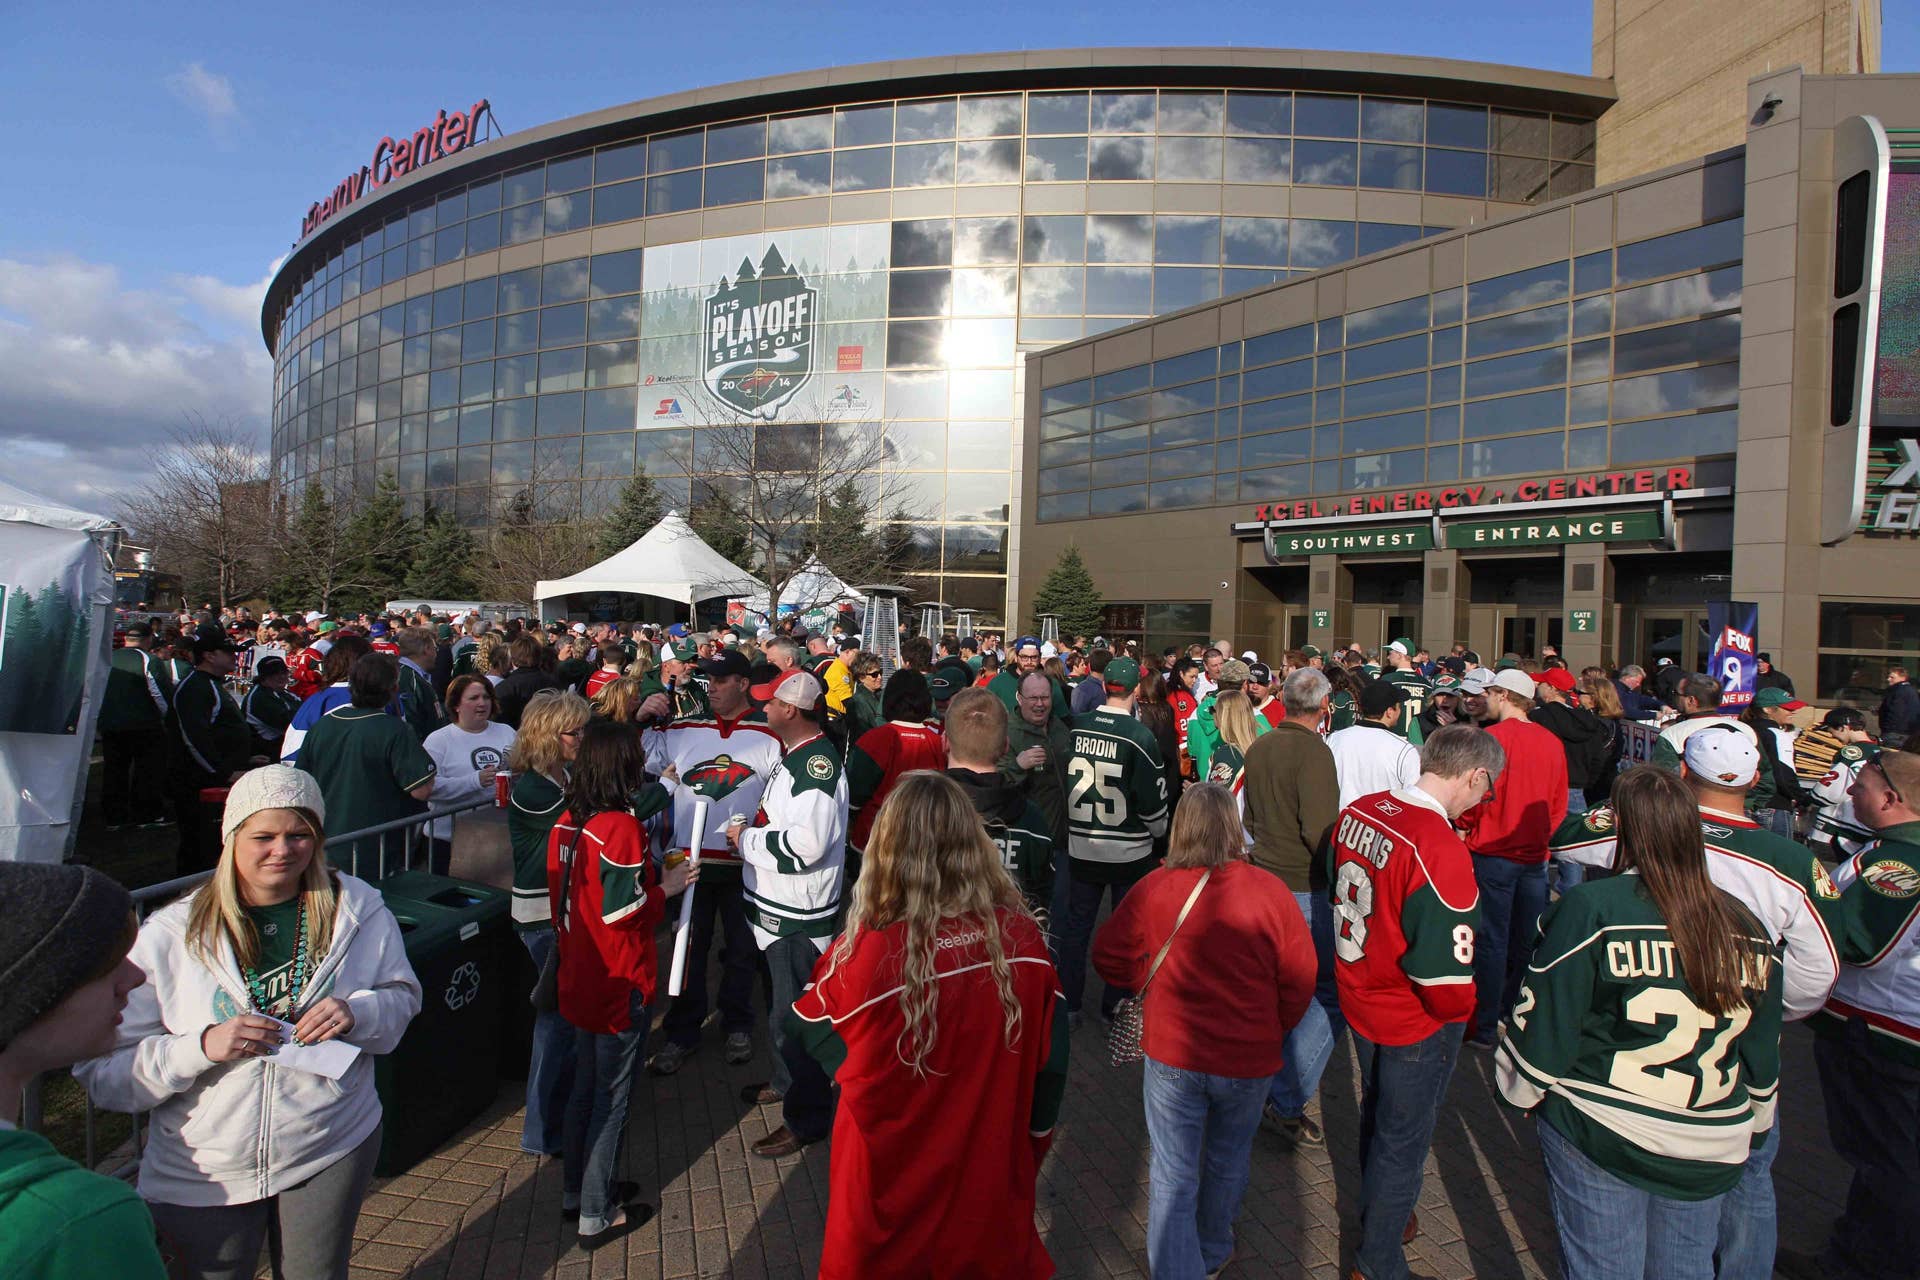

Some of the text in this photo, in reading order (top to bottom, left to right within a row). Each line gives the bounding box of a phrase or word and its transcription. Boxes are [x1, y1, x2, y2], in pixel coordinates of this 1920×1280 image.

[369, 98, 491, 190] Center
[713, 300, 739, 315] IT'S
[712, 293, 808, 352] PLAYOFF
[714, 332, 802, 363] SEASON
[721, 381, 735, 390] 20
[780, 378, 791, 387] 14
[1255, 468, 1691, 522] XCEL ENERGY CENTER
[1290, 533, 1416, 550] SOUTHWEST
[1474, 521, 1624, 542] ENTRANCE
[1318, 617, 1324, 626] 2
[1578, 619, 1586, 631] 2
[1727, 628, 1751, 653] FOX
[1724, 656, 1742, 692] 9
[1721, 693, 1751, 705] NEWS
[1075, 735, 1118, 760] BRODIN
[1067, 756, 1128, 827] 25
[1336, 814, 1395, 871] BURNS
[1333, 861, 1375, 964] 8
[935, 928, 985, 951] Reebok
[1452, 923, 1474, 965] 8
[1608, 986, 1753, 1109] 22
